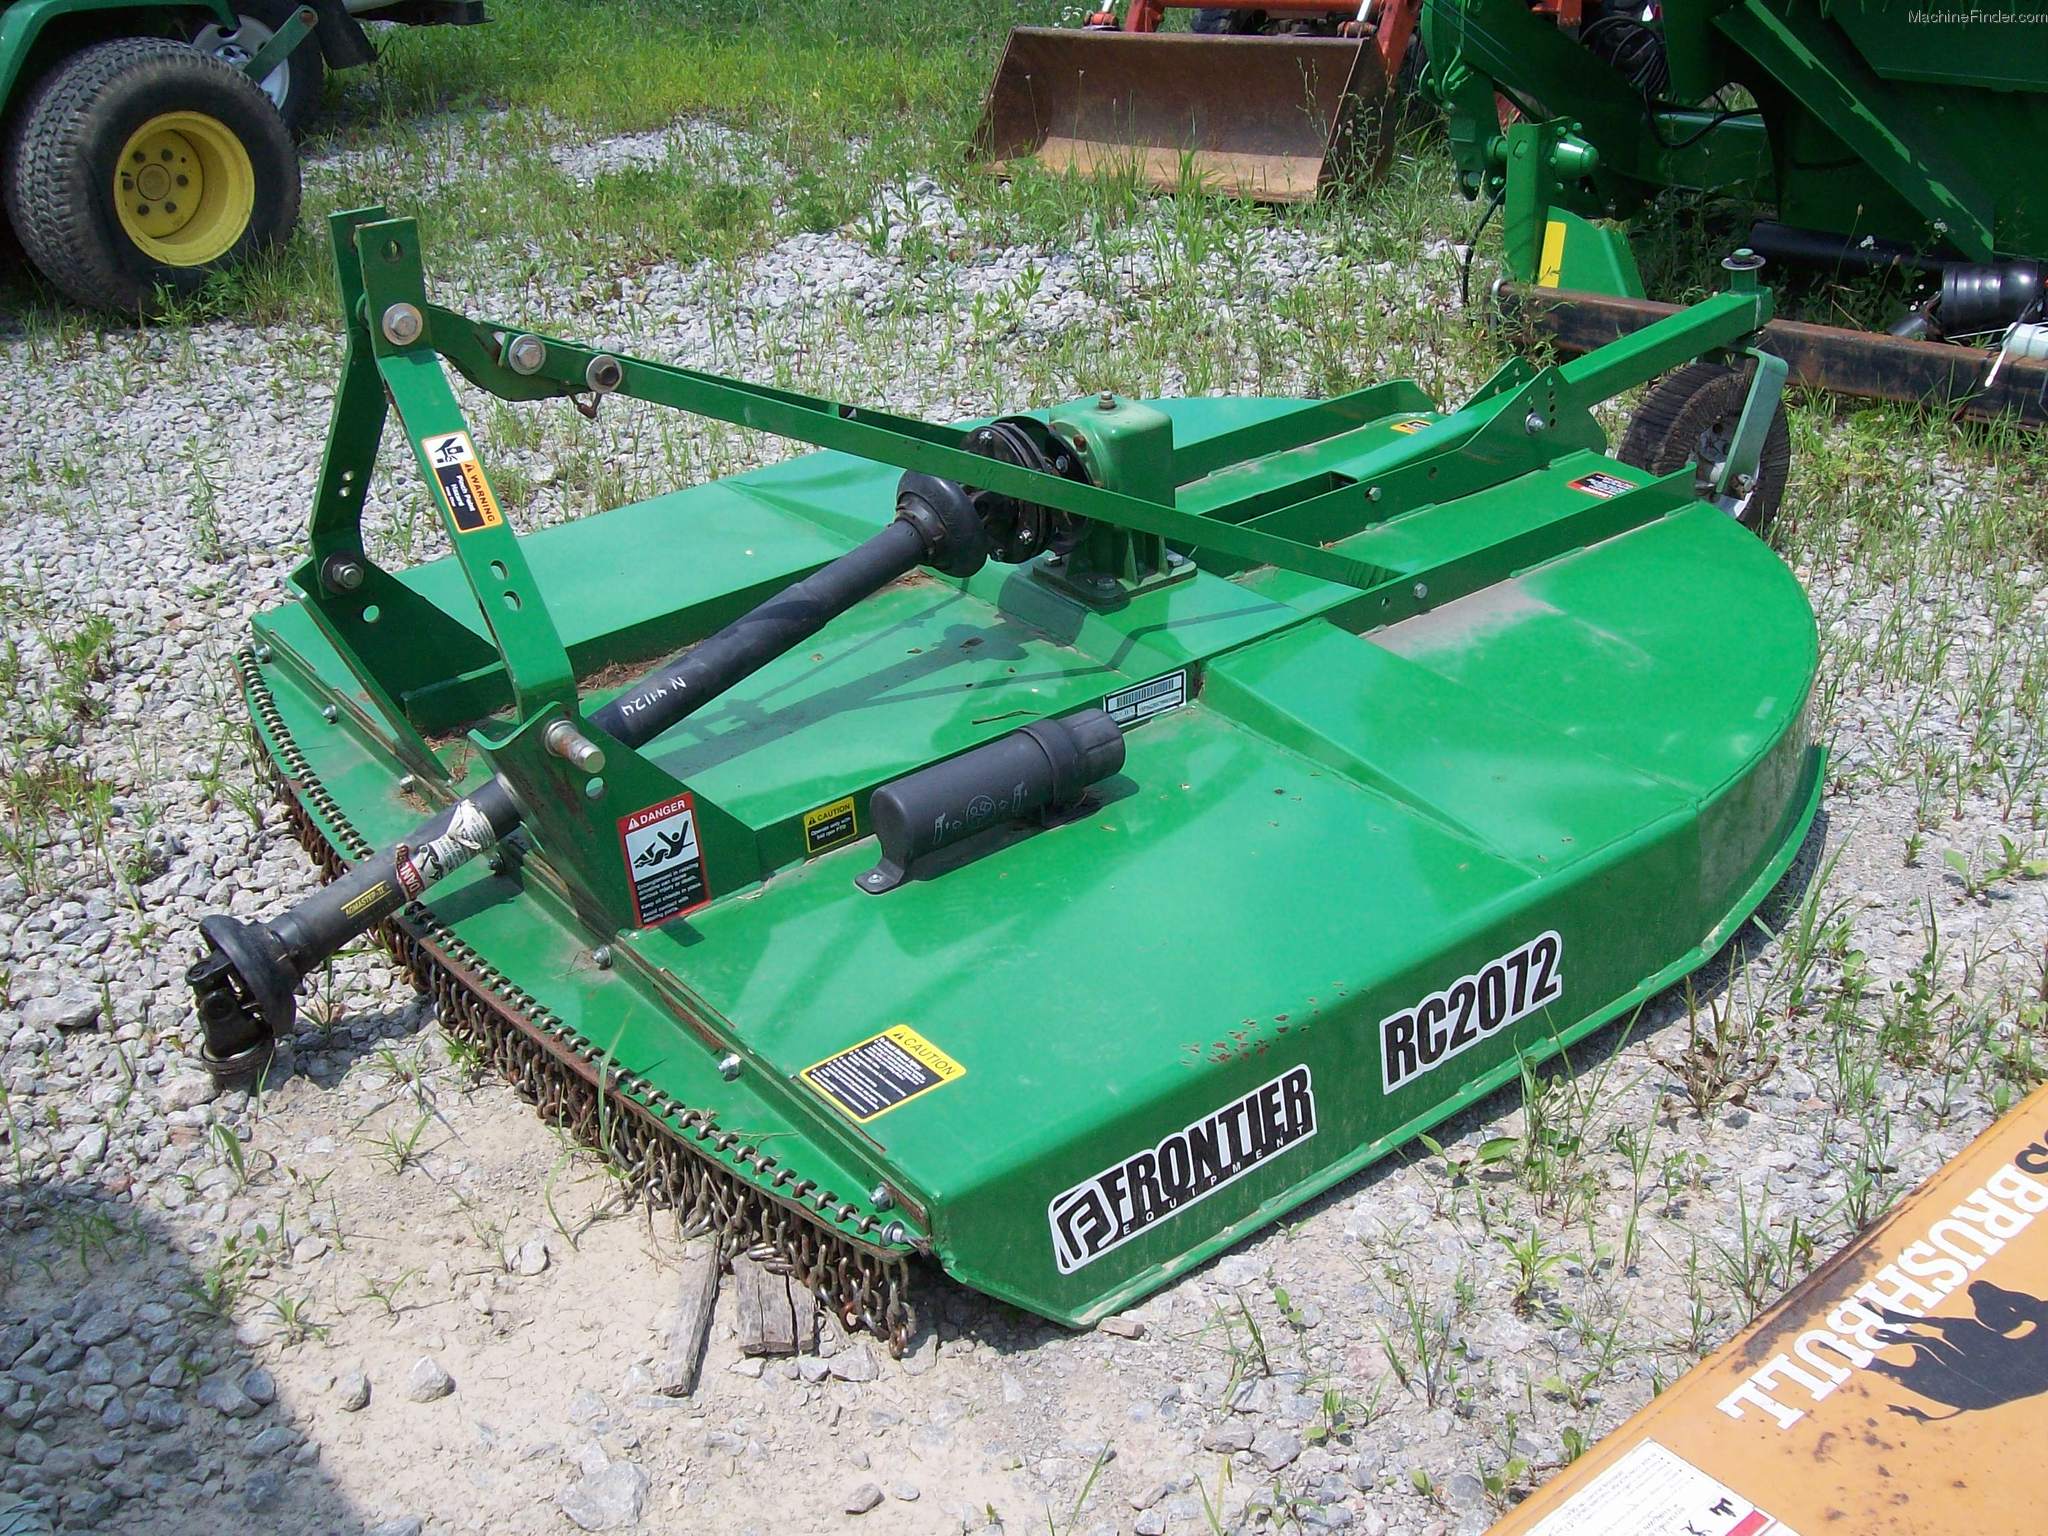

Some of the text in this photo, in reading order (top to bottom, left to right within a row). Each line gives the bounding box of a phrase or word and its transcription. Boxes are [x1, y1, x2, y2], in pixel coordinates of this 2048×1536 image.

[470, 474, 496, 522] WARNING
[639, 799, 686, 825] DANGER
[817, 803, 850, 821] CAUTION
[1385, 935, 1559, 1086] RC2072
[903, 1037, 957, 1076] CAUTION
[1097, 1067, 1314, 1235] FRONTIER
[1122, 1124, 1305, 1236] EQUIPMENT
